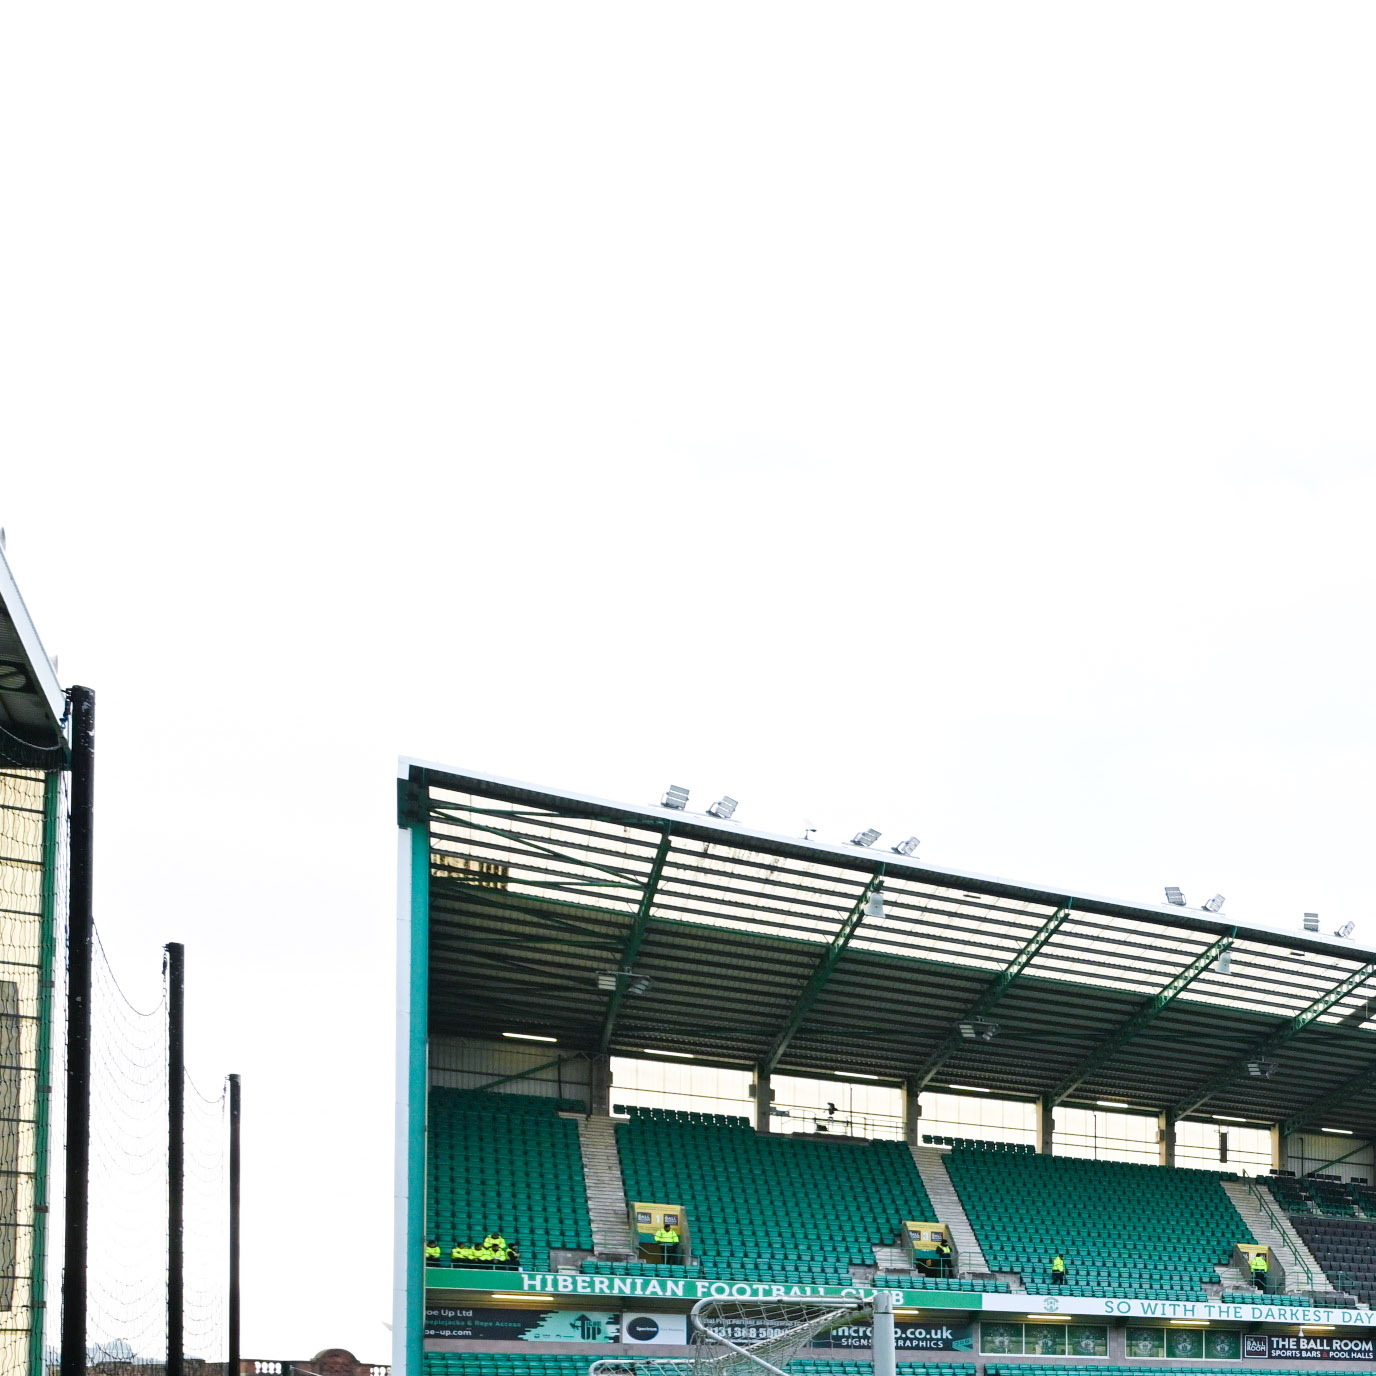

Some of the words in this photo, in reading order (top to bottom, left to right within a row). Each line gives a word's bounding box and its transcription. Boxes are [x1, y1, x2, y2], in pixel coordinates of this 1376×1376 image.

[521, 1273, 684, 1297] HIBERNIAN
[441, 1310, 455, 1318] Up
[1104, 1300, 1131, 1315] SO
[1140, 1302, 1195, 1318] WITH
[1204, 1304, 1242, 1320] THE
[1252, 1307, 1333, 1323] DARKEST
[1271, 1338, 1297, 1349] THE
[1301, 1338, 1330, 1350] BALL
[1332, 1340, 1373, 1352] ROOM
[1271, 1350, 1300, 1358] SPORTS
[1302, 1350, 1321, 1358] BARS
